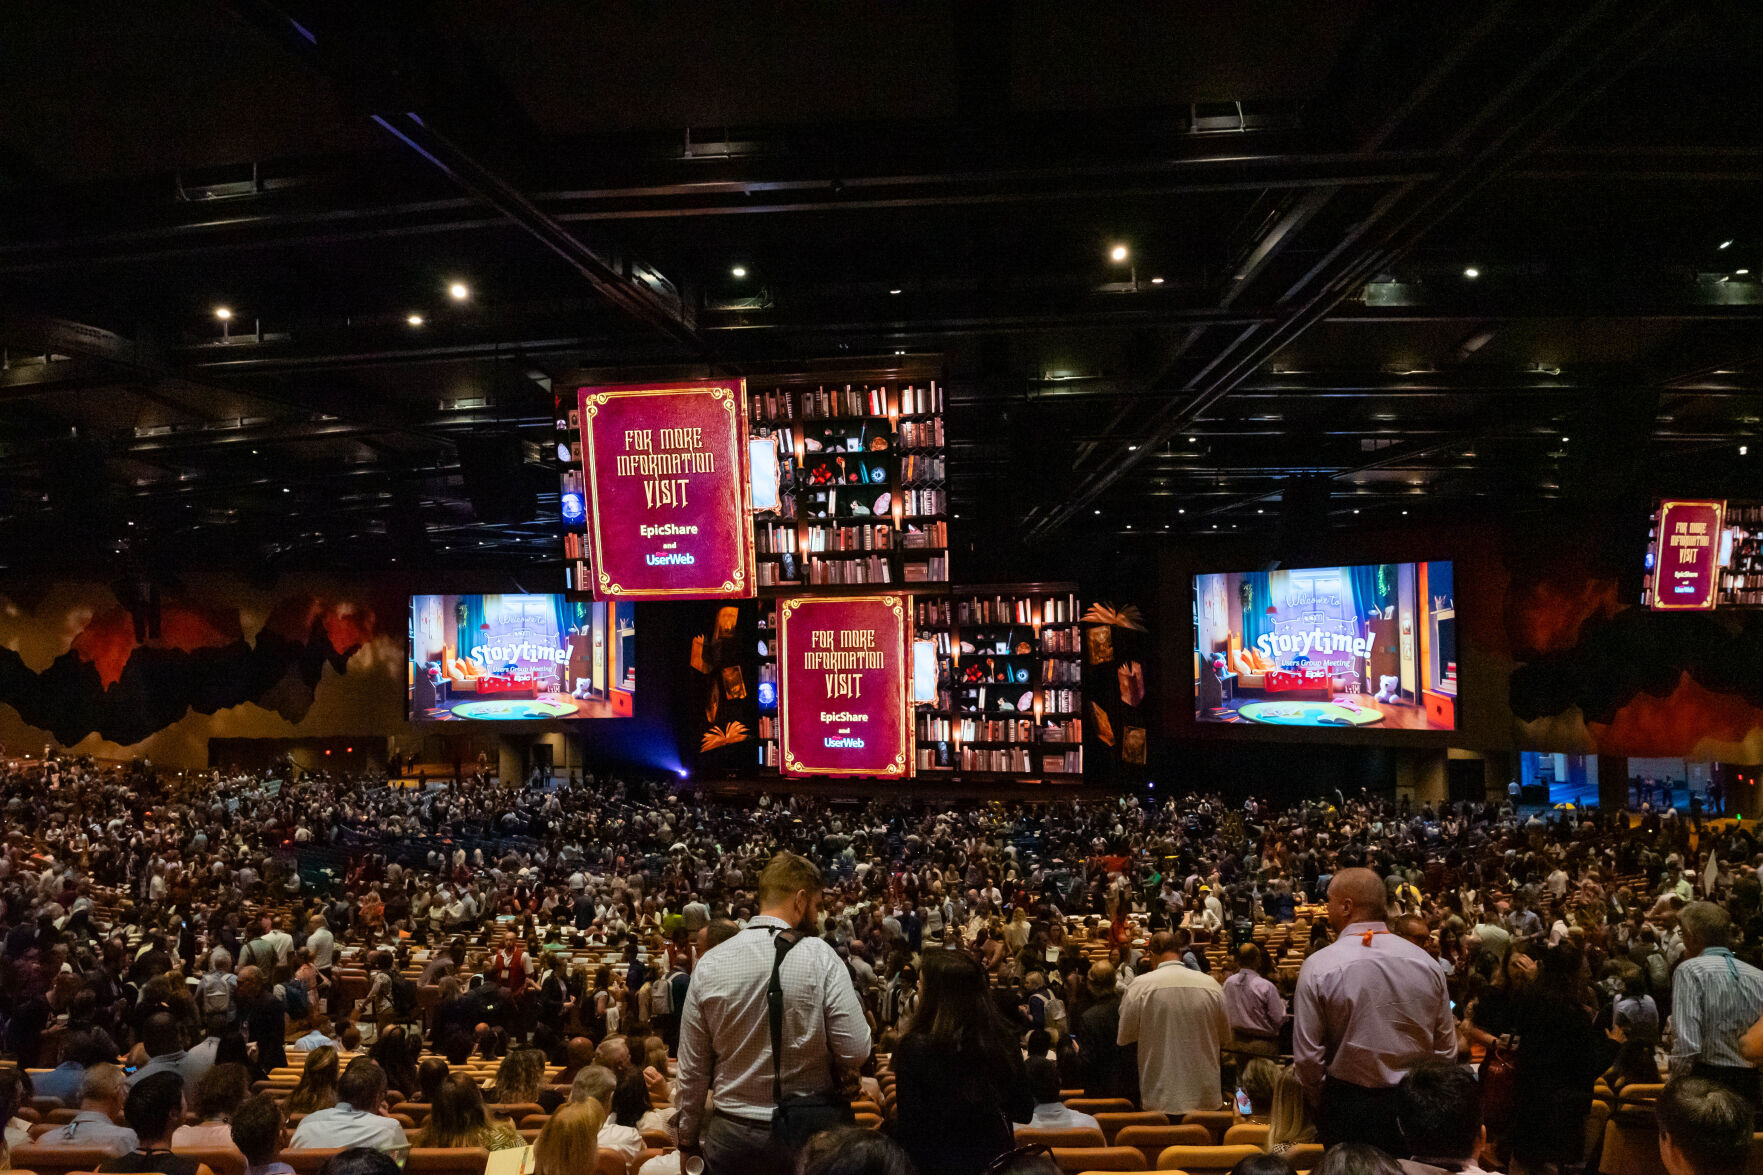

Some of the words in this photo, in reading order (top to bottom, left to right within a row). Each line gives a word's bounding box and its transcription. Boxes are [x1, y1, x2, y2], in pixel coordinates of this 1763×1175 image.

[625, 430, 652, 454] FOR
[660, 428, 703, 453] MORE
[616, 453, 715, 478] INFORMATION
[643, 479, 690, 509] VISIT
[640, 524, 698, 538] EpicShare
[662, 541, 677, 549] and
[646, 552, 695, 565] UserWeb
[811, 630, 834, 650] FOR
[840, 630, 875, 650] MORE
[1257, 627, 1376, 659] Storytime!
[471, 641, 574, 666] Storytime!
[804, 651, 884, 671] INFORMATION
[1305, 670, 1325, 679] Epic
[825, 673, 863, 699] VISIT
[820, 711, 869, 724] EpicShare
[824, 737, 865, 748] UserWeb
